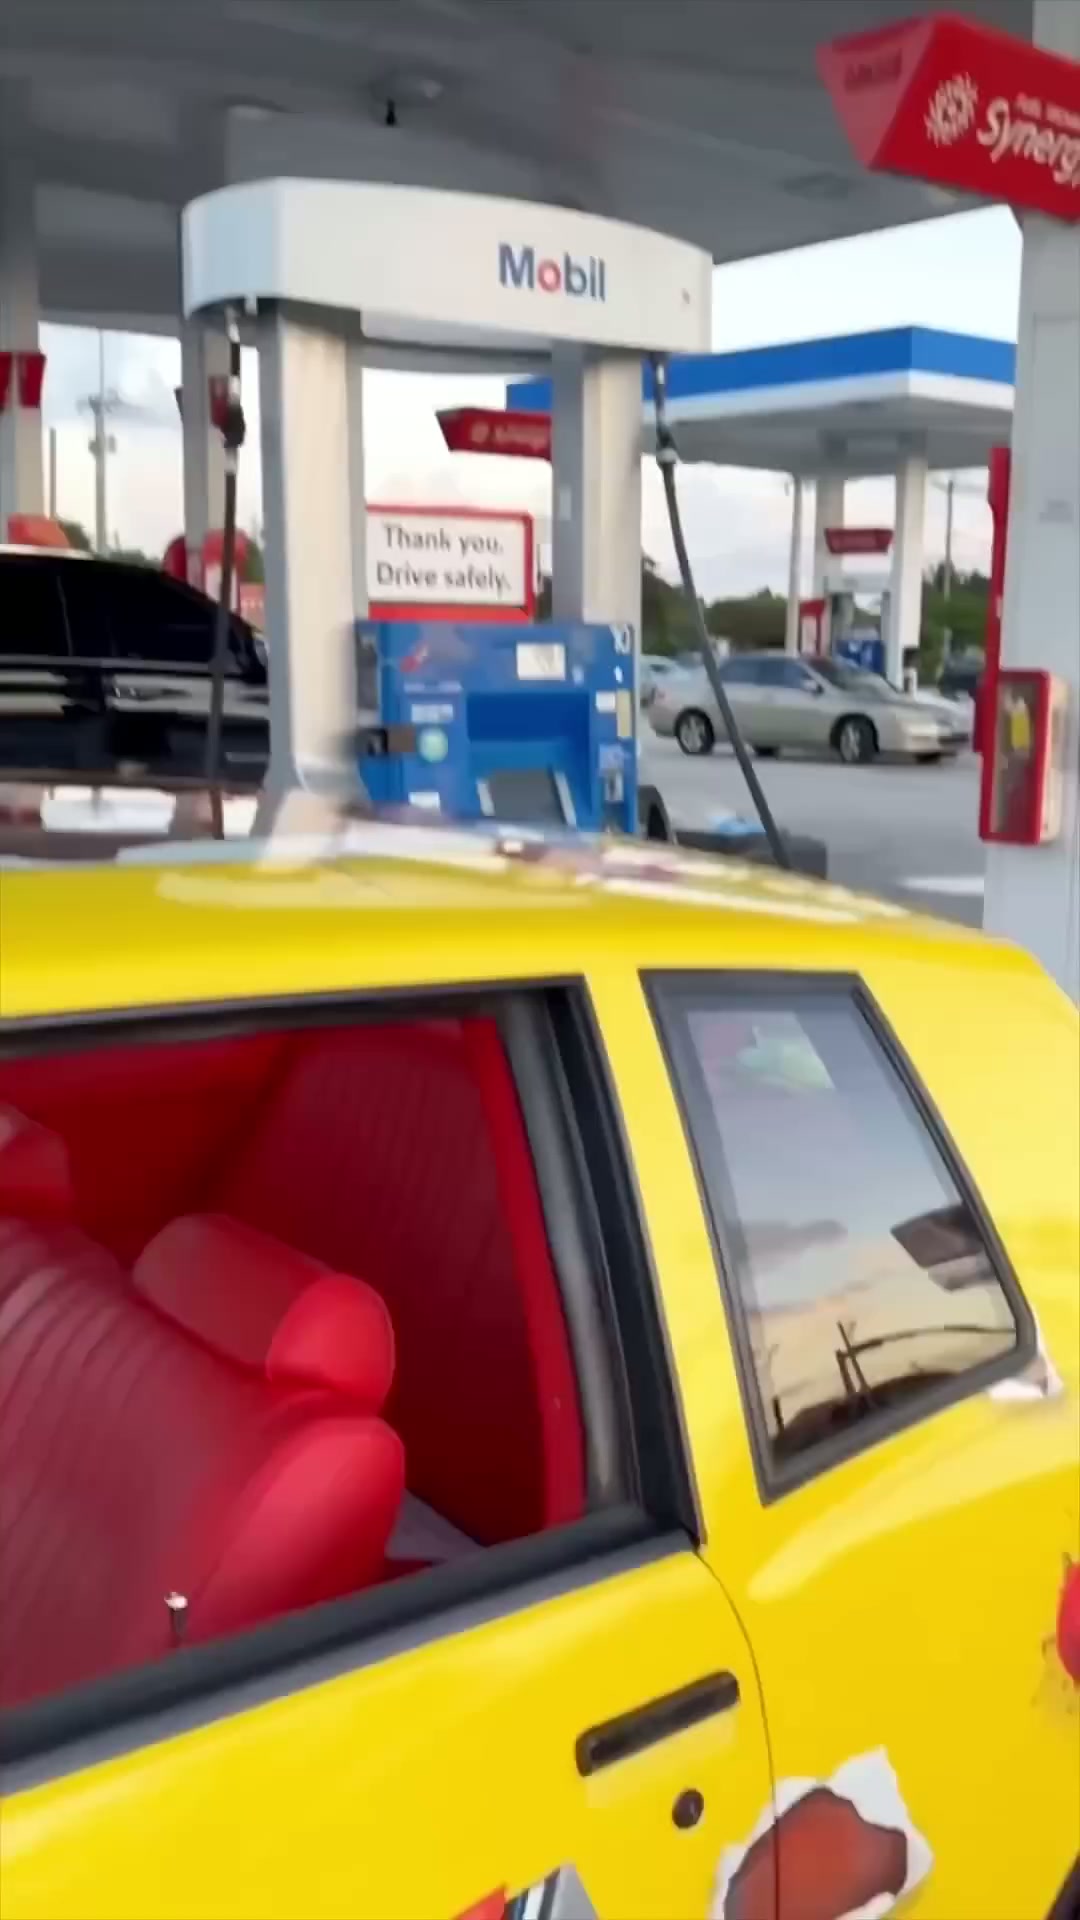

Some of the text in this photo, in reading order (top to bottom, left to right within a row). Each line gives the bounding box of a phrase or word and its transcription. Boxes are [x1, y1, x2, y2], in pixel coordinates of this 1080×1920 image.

[976, 96, 1080, 189] Synerg
[498, 241, 606, 302] Mobil
[384, 523, 451, 552] Thank
[376, 560, 512, 600] Drive safely.
